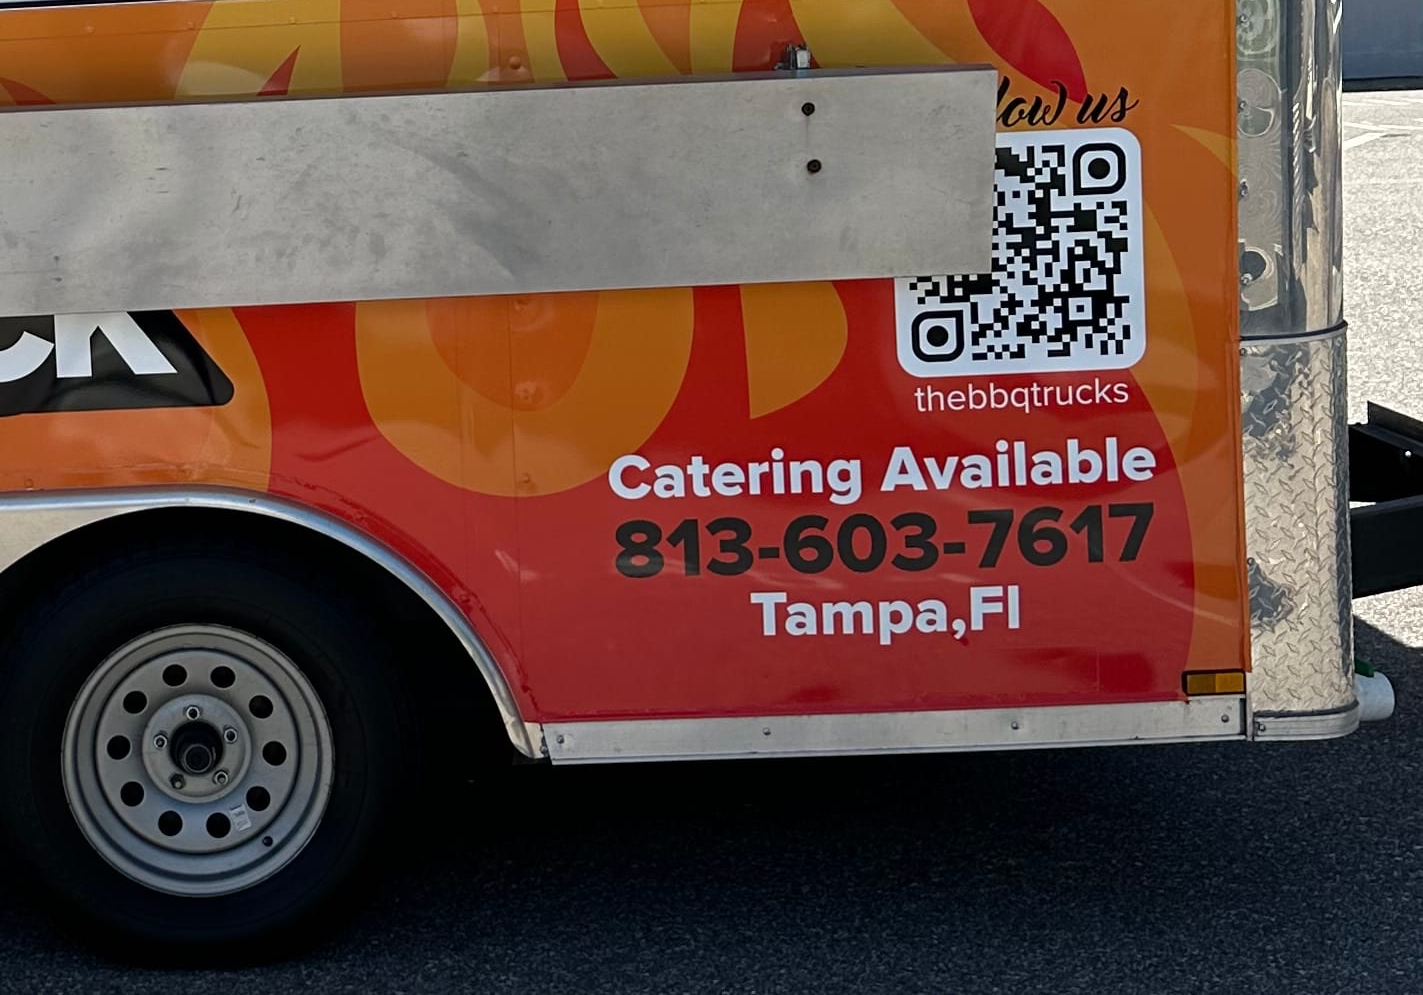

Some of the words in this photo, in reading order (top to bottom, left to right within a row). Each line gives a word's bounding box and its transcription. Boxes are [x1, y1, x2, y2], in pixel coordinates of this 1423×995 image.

[1076, 87, 1140, 124] us
[913, 378, 1130, 414] thebbqtrucks
[608, 447, 863, 504] Catering
[880, 437, 1157, 492] Available
[614, 501, 1156, 579] 813-603-7617
